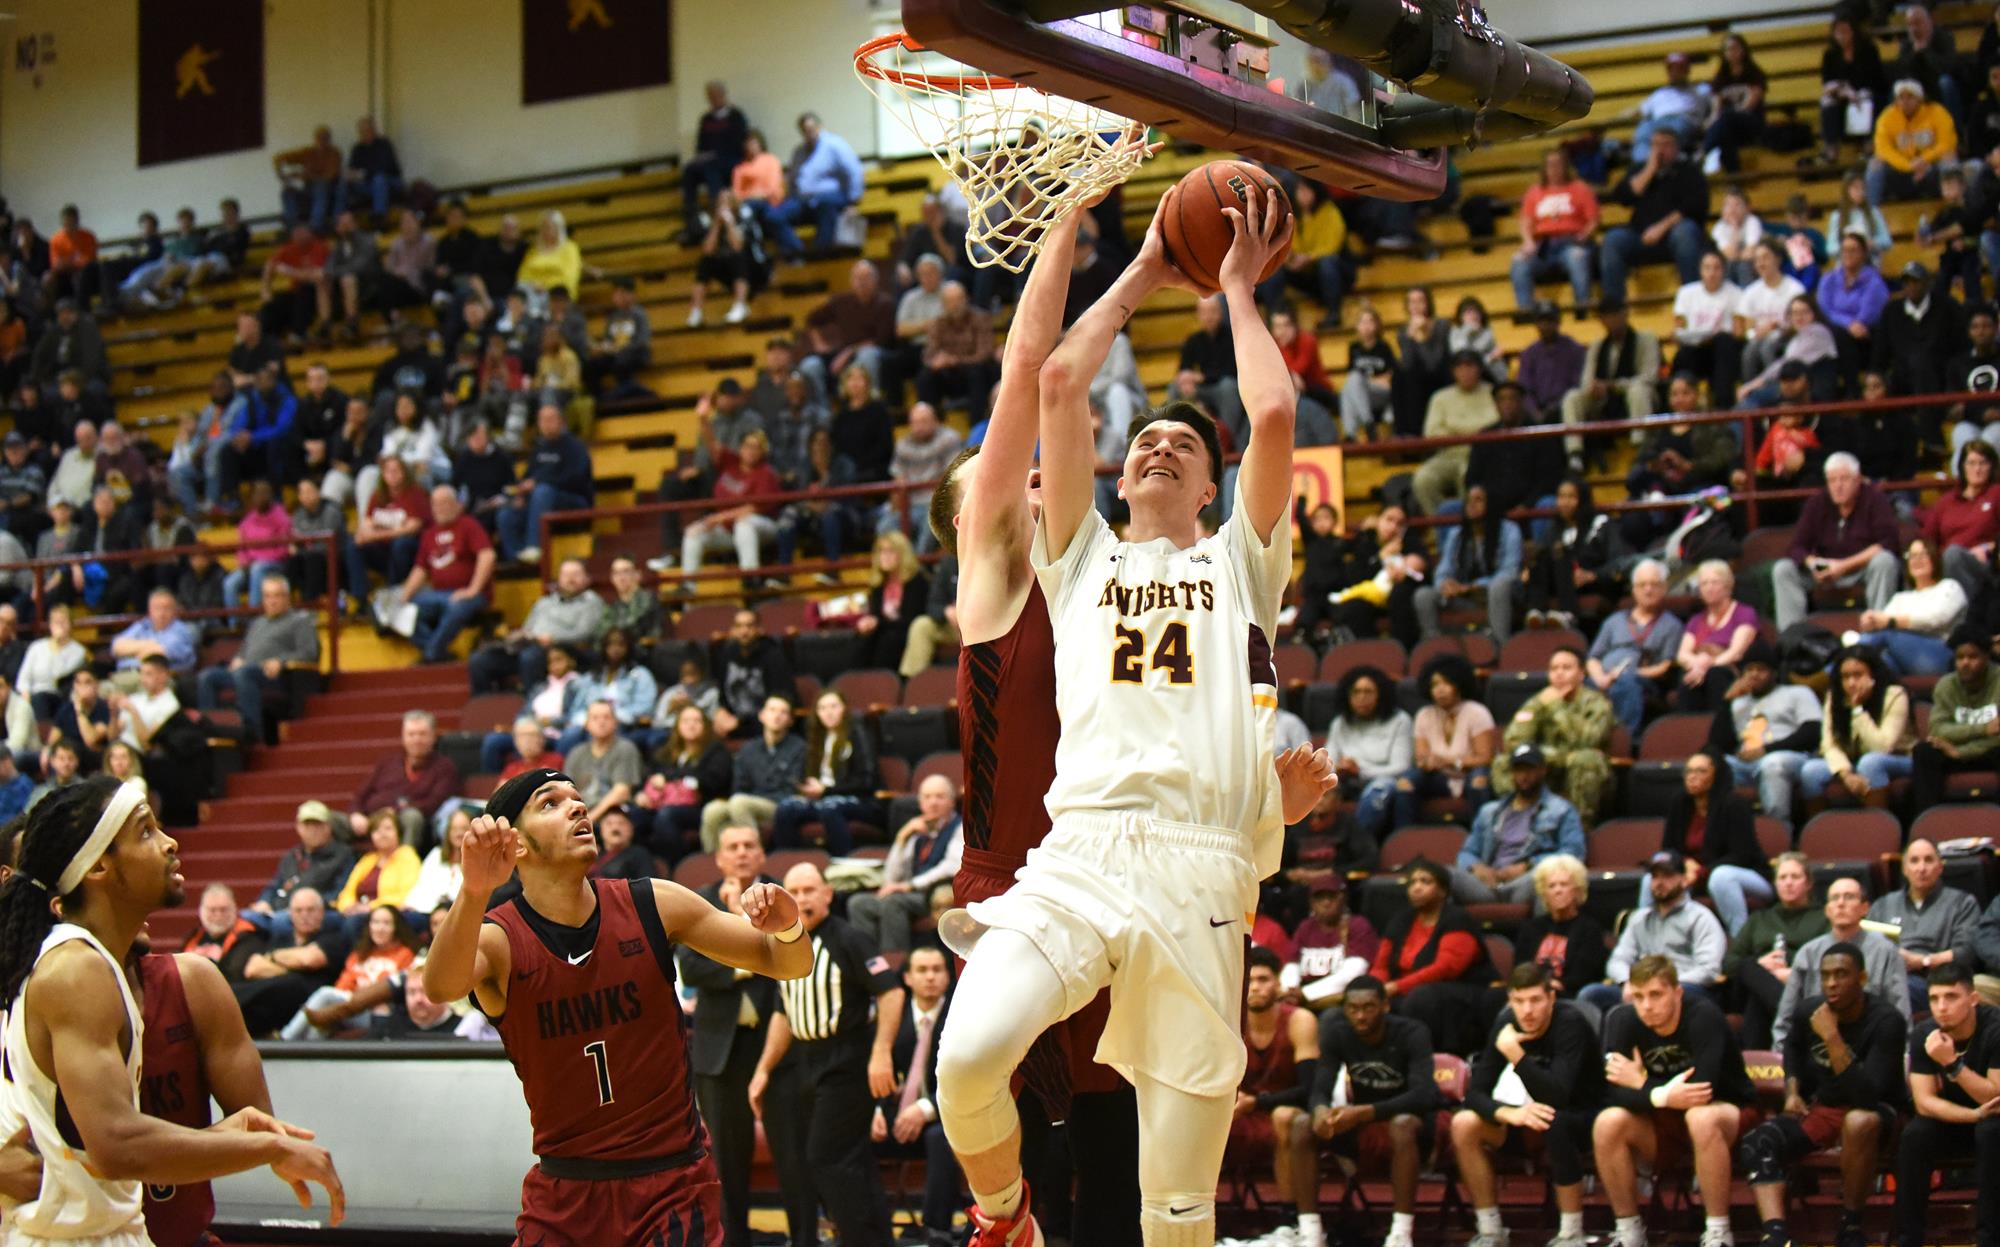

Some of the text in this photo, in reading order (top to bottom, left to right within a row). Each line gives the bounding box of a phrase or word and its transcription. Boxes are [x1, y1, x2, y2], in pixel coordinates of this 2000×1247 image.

[1097, 577, 1214, 617] KNIGHTS
[1110, 619, 1196, 686] 24
[536, 980, 643, 1040] HAWKS
[583, 1040, 615, 1107] 1
